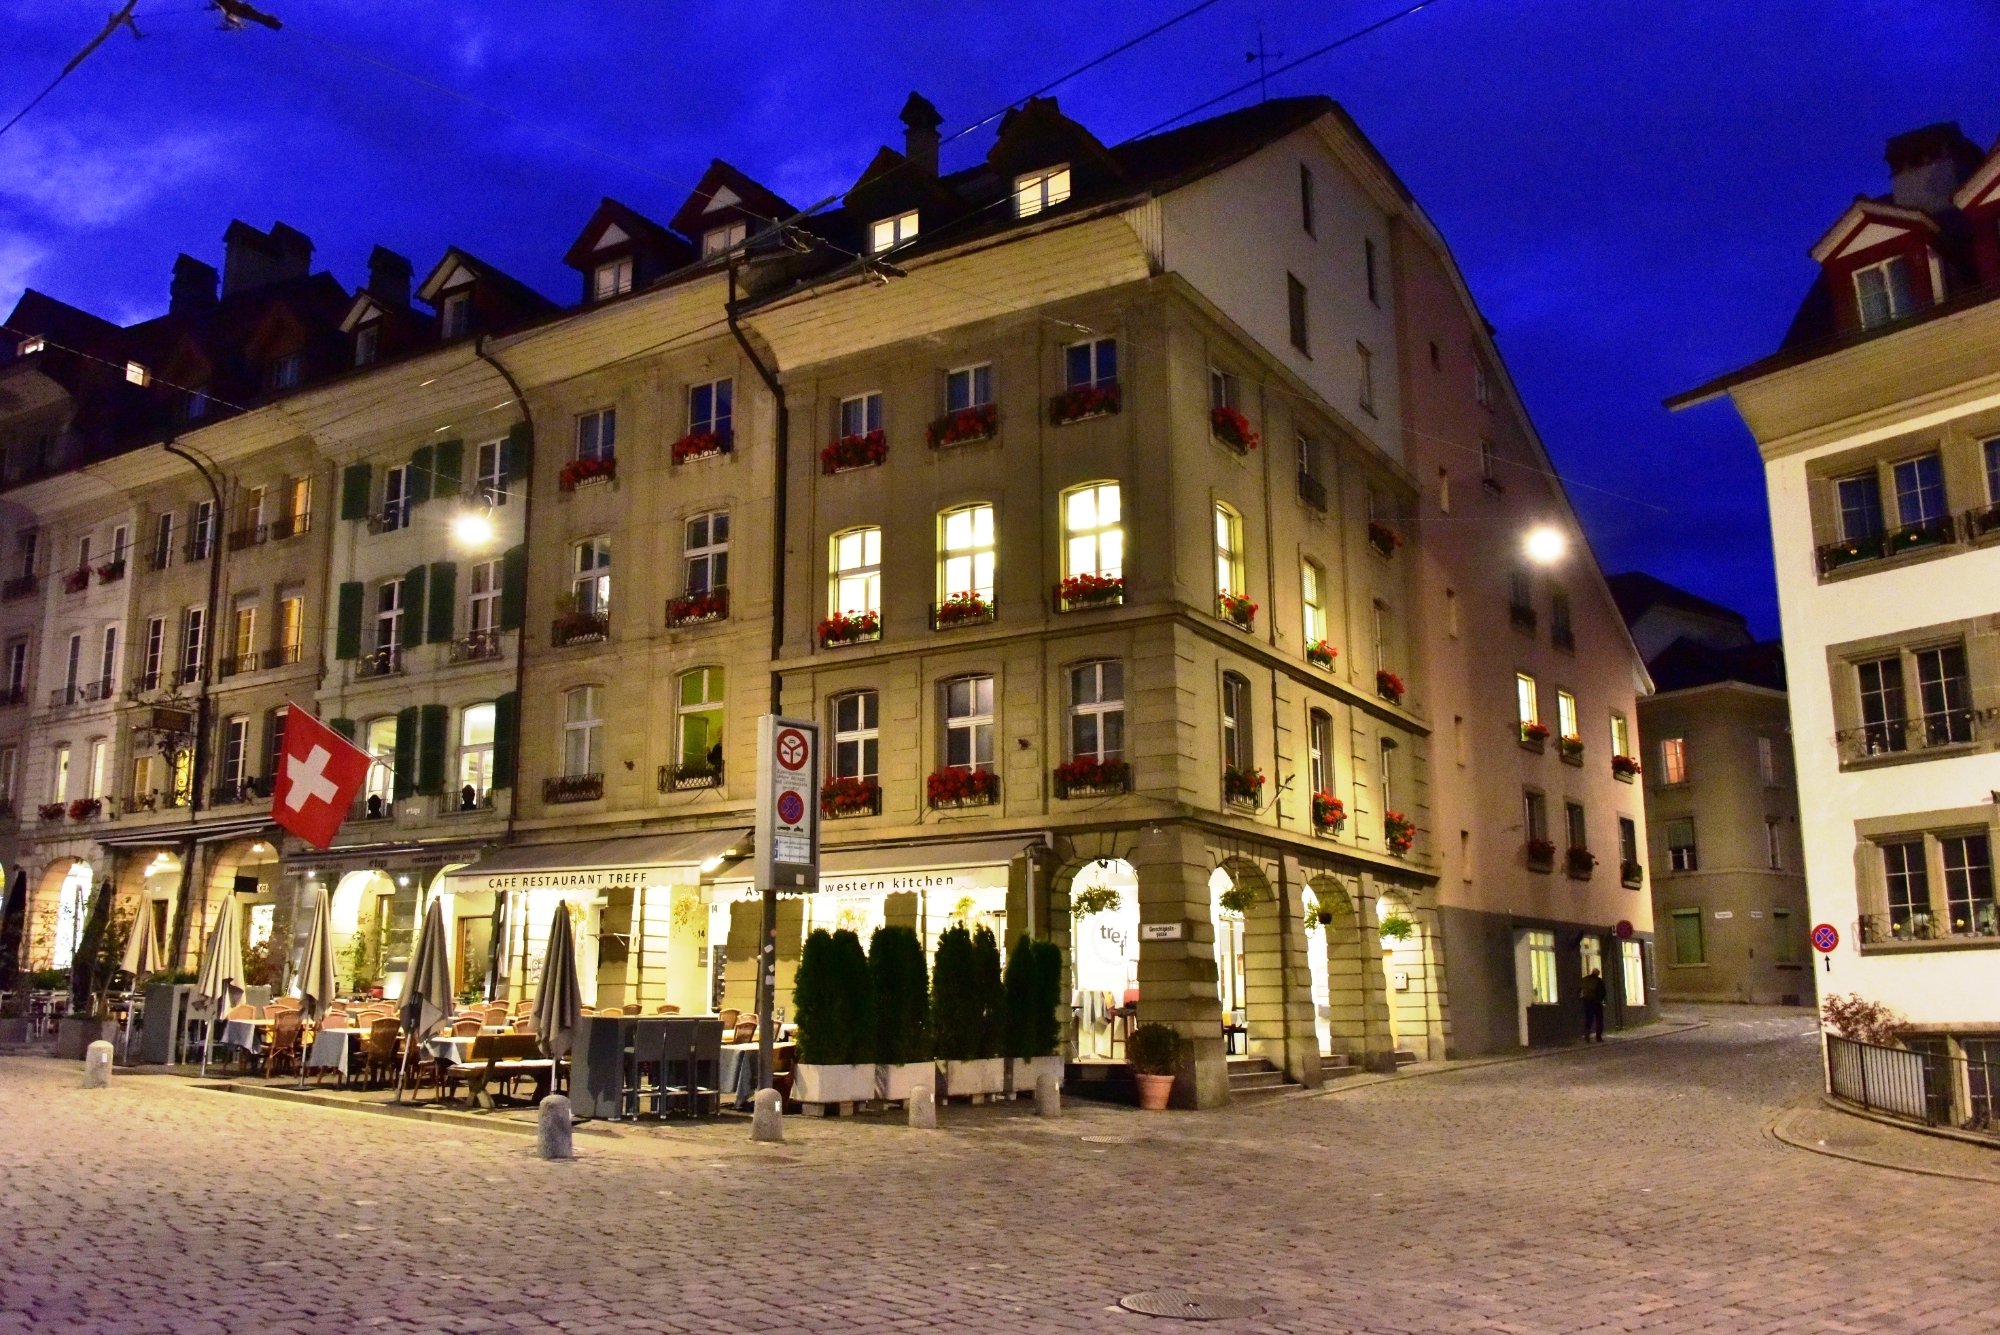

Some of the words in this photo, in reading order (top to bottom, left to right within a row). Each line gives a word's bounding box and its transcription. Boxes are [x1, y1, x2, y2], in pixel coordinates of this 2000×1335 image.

[488, 875, 517, 888] CAFÉ
[522, 874, 603, 887] RESTAURANT
[608, 872, 647, 884] TREFF
[825, 881, 885, 892] western
[893, 875, 954, 888] kitchen
[711, 904, 718, 913] 14
[697, 929, 706, 938] 14
